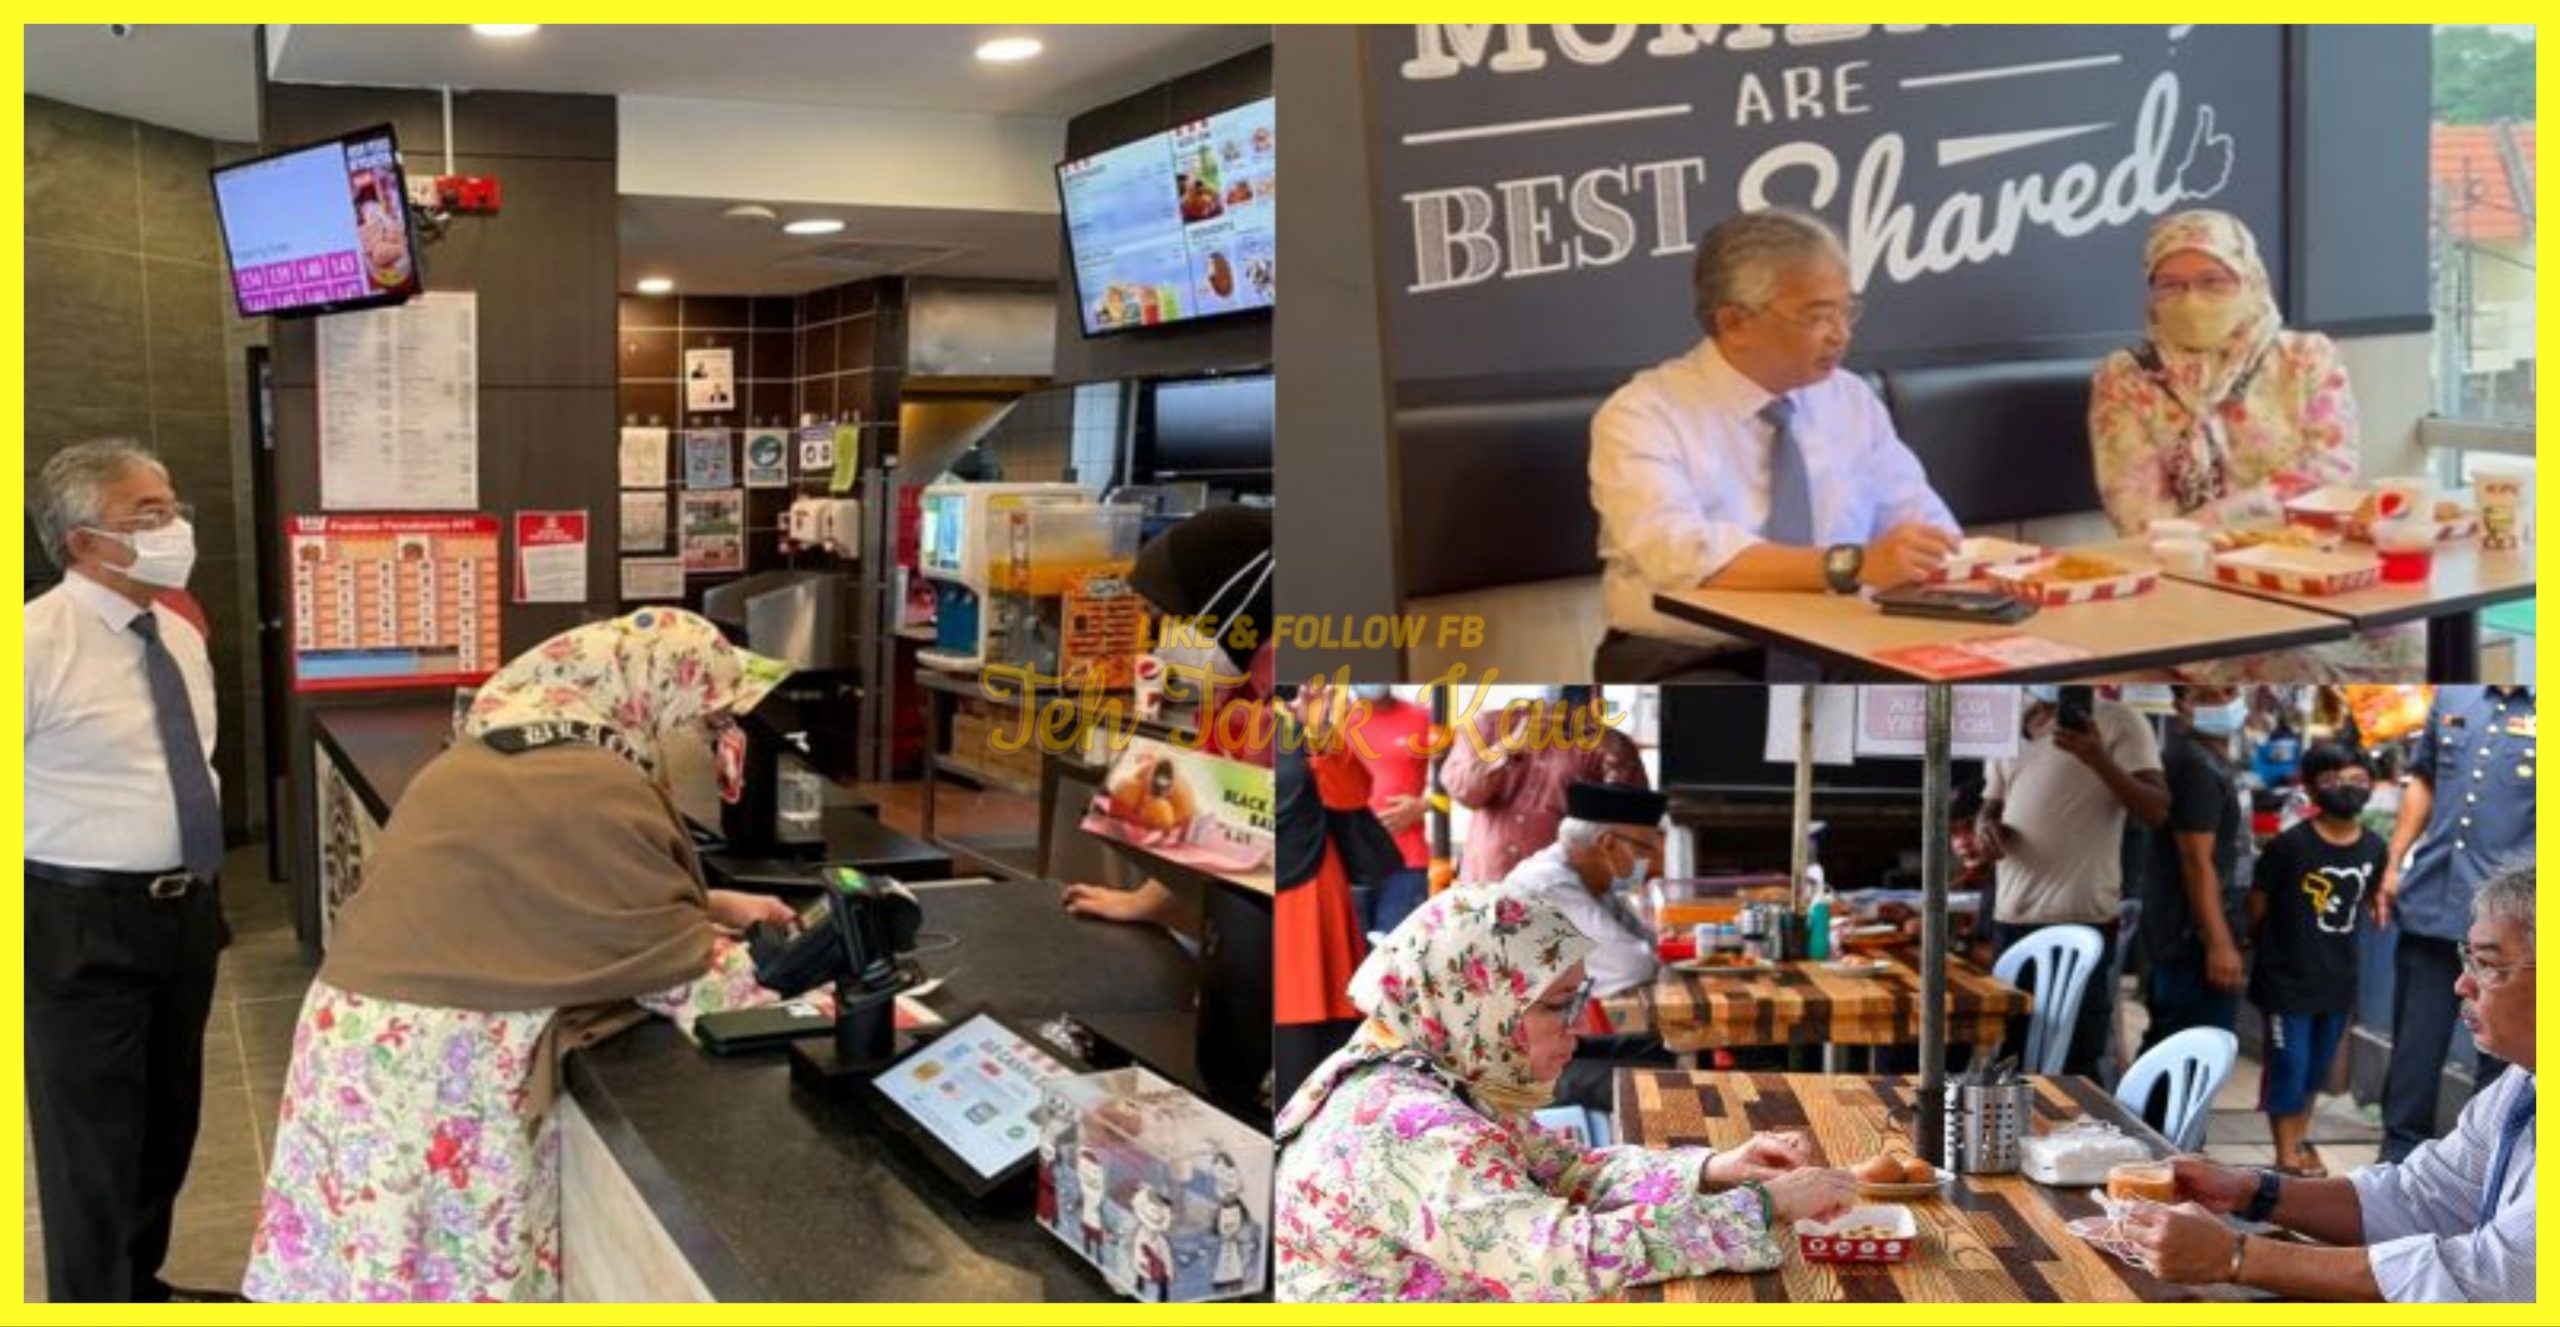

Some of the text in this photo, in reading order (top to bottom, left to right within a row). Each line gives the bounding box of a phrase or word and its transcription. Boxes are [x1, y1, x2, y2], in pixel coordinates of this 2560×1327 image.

[1736, 59, 1871, 126] ARE
[1402, 157, 1705, 293] BEST
[1222, 788, 1268, 811] BLACK
